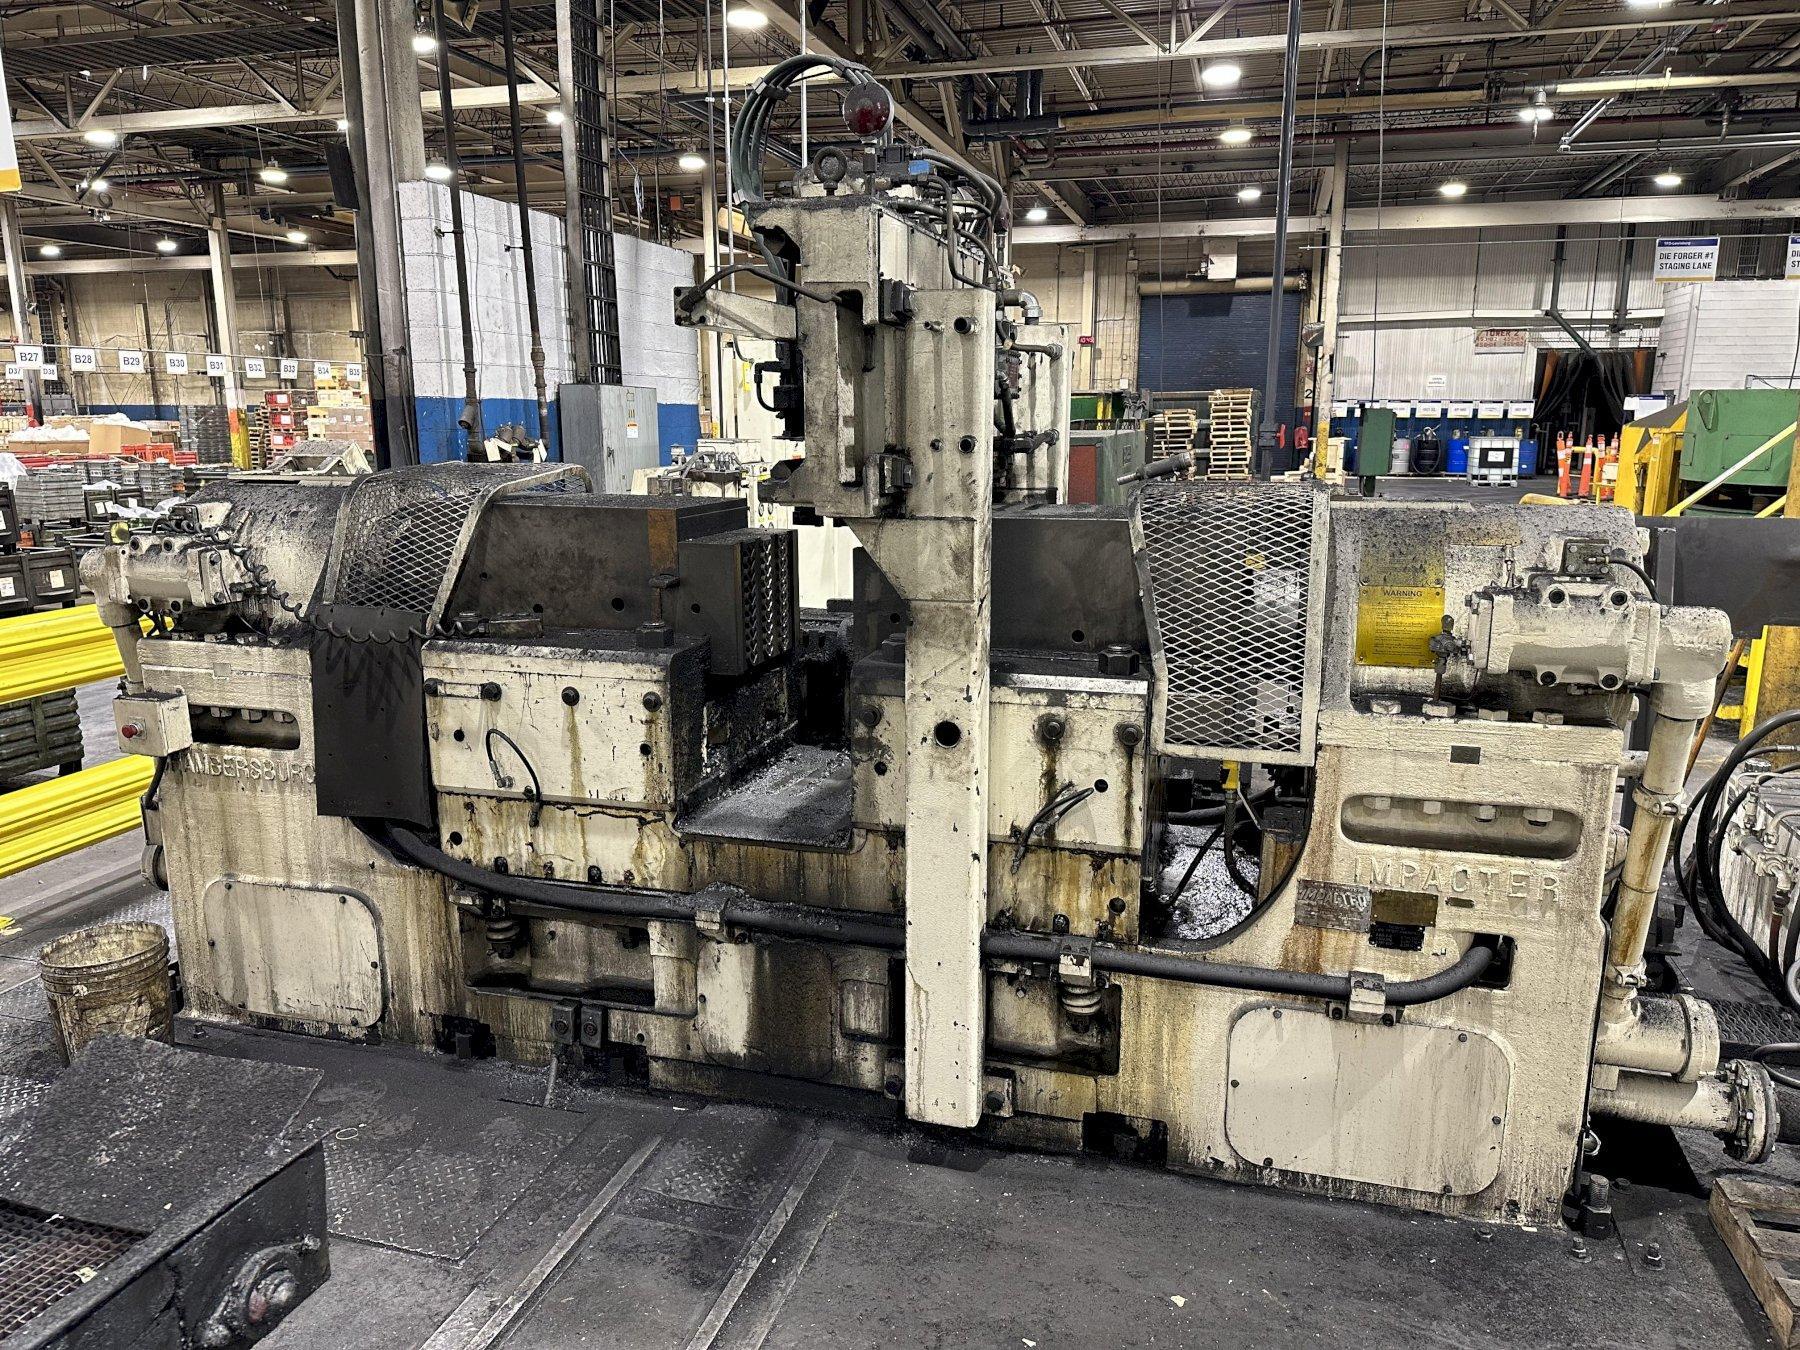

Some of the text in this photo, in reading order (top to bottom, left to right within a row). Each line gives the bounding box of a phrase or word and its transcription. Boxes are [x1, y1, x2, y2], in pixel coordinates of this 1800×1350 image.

[1659, 251, 1714, 260] DIE FORGER #1
[1659, 262, 1712, 270] STAGING LANE
[19, 352, 39, 362] B27
[74, 354, 92, 364] B28
[123, 356, 141, 366] B29
[169, 359, 185, 368] B30
[209, 361, 224, 370] B31
[248, 363, 263, 372] B32
[43, 368, 55, 376] D38
[283, 365, 296, 373] B33
[317, 366, 330, 375] B34
[349, 368, 360, 376] B35
[1305, 389, 1313, 398] 2
[169, 752, 316, 784] AMBERSBURG
[1354, 856, 1561, 902] IMPACTER
